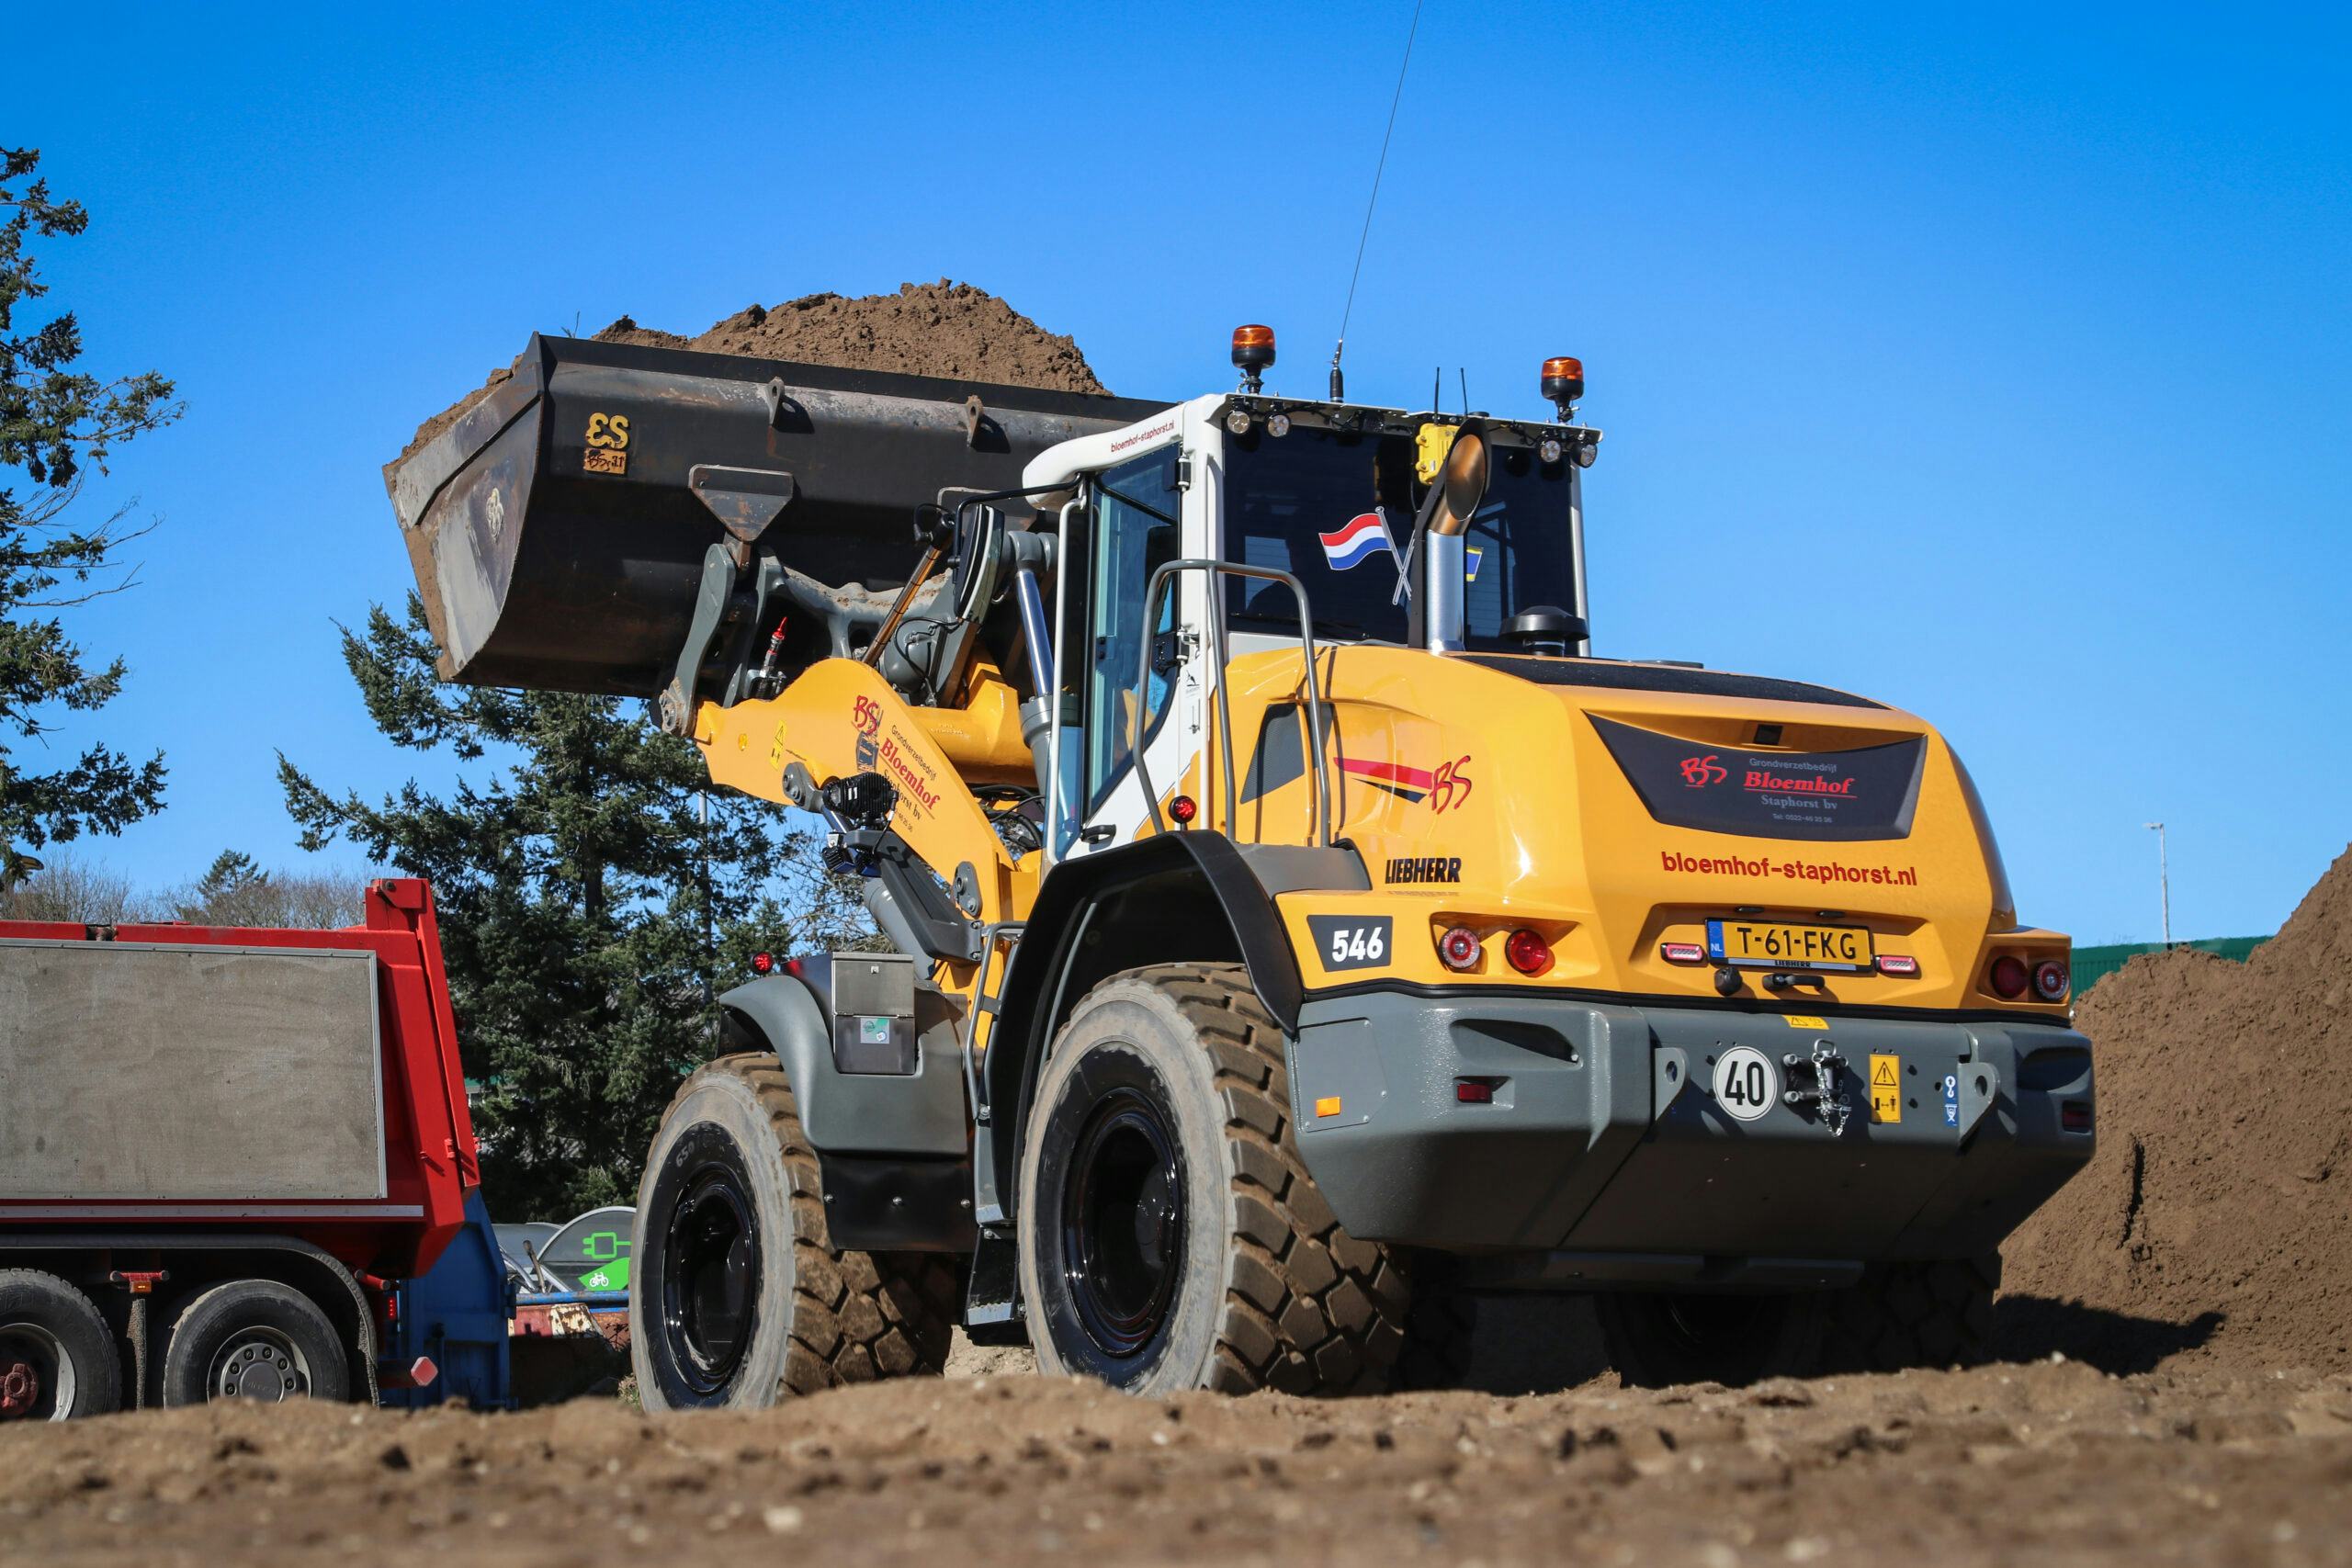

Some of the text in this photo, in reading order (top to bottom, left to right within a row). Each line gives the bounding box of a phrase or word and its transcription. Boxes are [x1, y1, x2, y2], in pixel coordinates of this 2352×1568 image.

[1111, 419, 1175, 453] bloemhof-staphorst.nl
[854, 694, 879, 735] BS
[891, 724, 937, 781] Grondverzetbedrijf
[1748, 758, 1838, 773] Grondverzetbedrijf
[880, 737, 941, 810] Bloemhof
[1429, 755, 1472, 815] BS
[1679, 755, 1728, 786] BS
[1743, 771, 1856, 794] Bloemhof
[1760, 794, 1838, 809] Staphorst bv
[1385, 857, 1463, 885] LIEBHERR
[1661, 851, 1917, 886] bloemhof-staphorst.nl
[1332, 927, 1385, 963] 546
[1710, 942, 1723, 953] NL
[1736, 926, 1857, 961] T-61-FKG
[1724, 1060, 1766, 1107] 40
